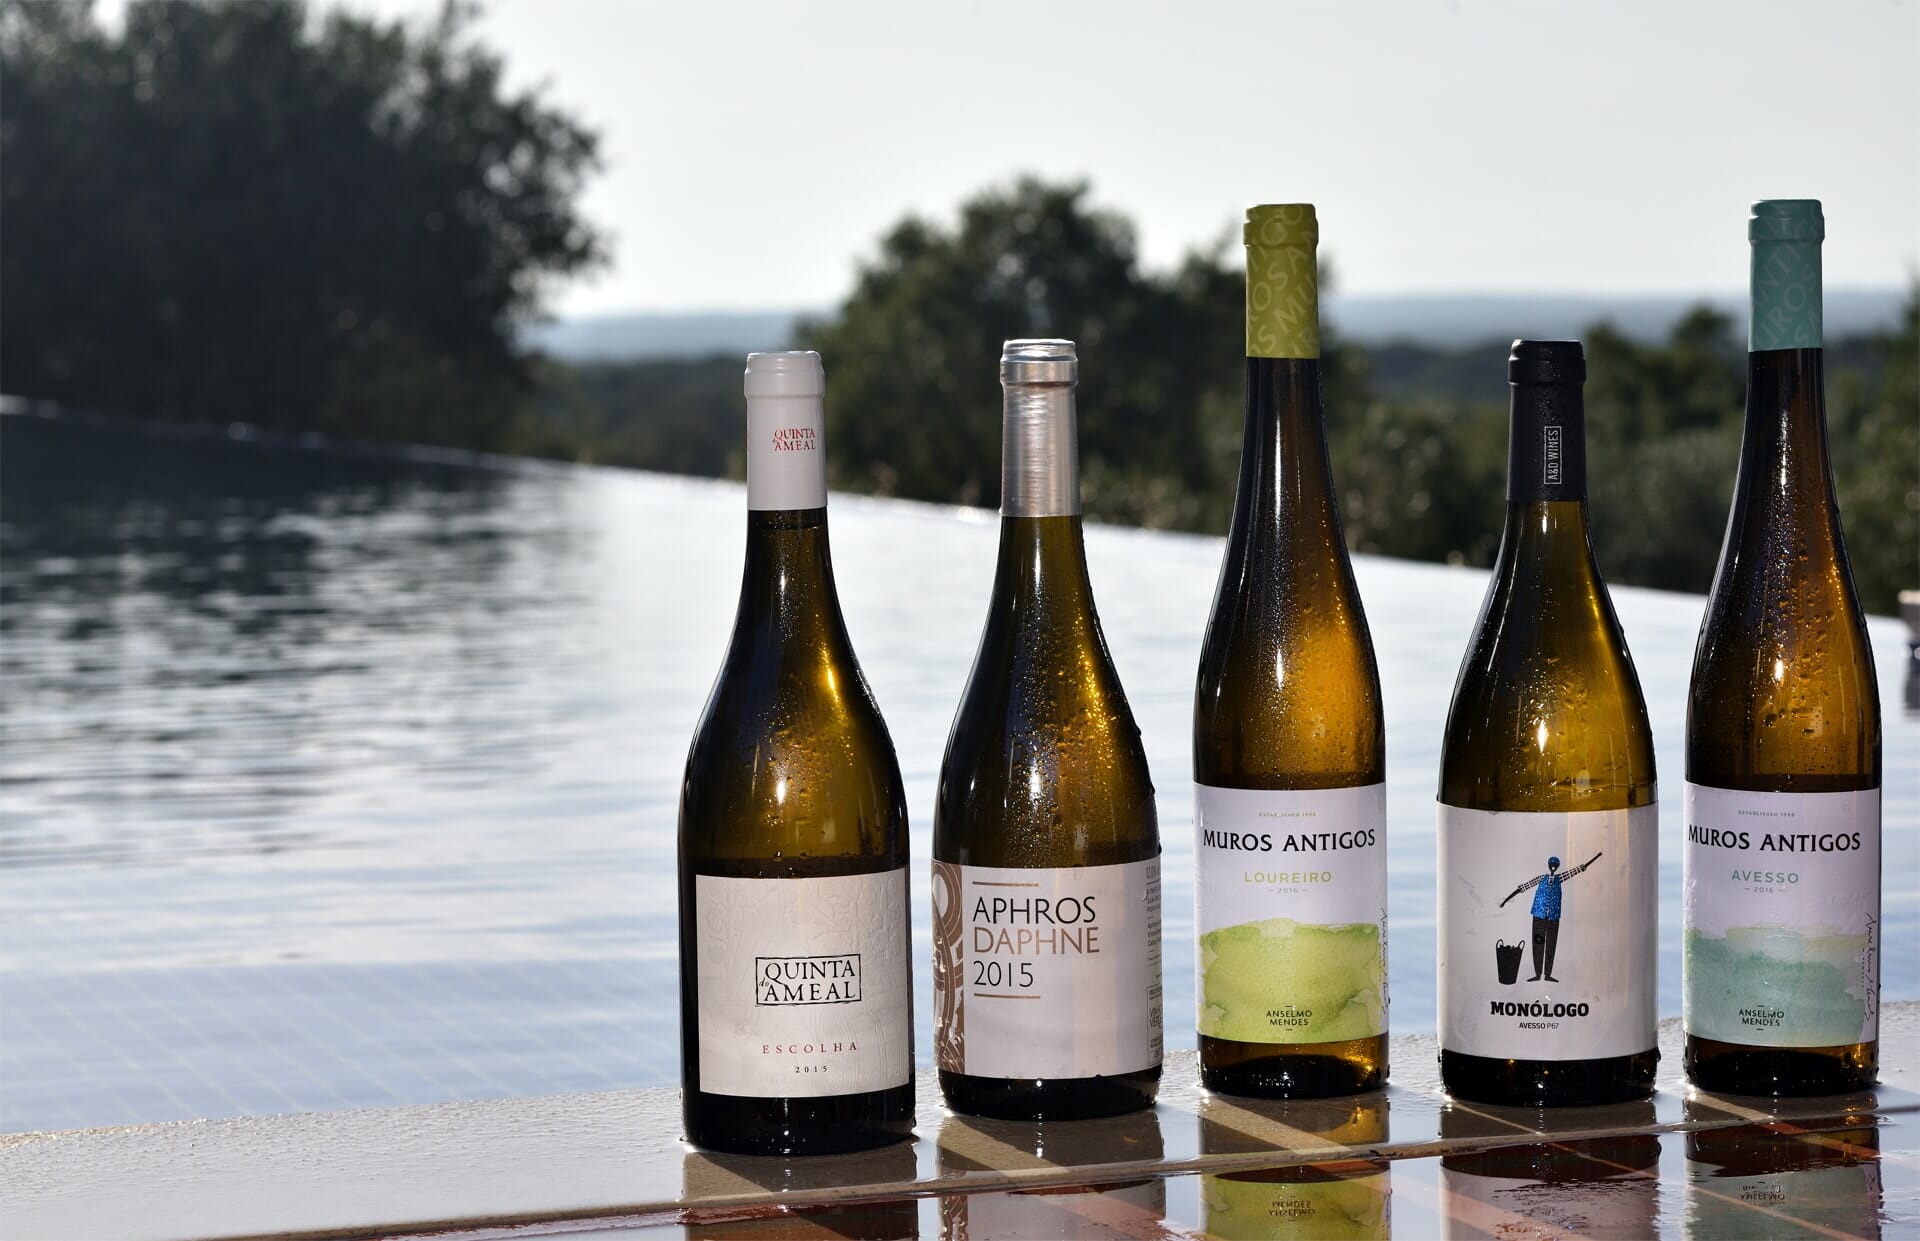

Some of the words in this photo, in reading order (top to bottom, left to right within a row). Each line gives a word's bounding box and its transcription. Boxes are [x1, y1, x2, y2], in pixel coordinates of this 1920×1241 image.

[774, 428, 816, 441] QUINTA
[774, 439, 816, 451] AMEAL
[1547, 430, 1559, 461] WINES
[1547, 462, 1559, 480] A&D
[1203, 828, 1273, 852] MUROS
[1282, 828, 1376, 852] ANTIGOS
[1688, 824, 1750, 850] MUROS
[1759, 832, 1861, 852] ANTIGOS
[1244, 871, 1333, 884] LOUREIRO
[1731, 869, 1799, 884] AVESSO
[1753, 886, 1774, 894] 2016
[972, 896, 1096, 924] APHROS
[973, 926, 1101, 955] DAPHNE
[765, 959, 856, 985] QUINTA
[973, 960, 1034, 988] 2015
[764, 981, 856, 1001] AMEAL
[1266, 1010, 1313, 1018] ANSELMO
[1490, 1000, 1590, 1018] MONÓLOGO
[1738, 1008, 1785, 1018] ANSELMO
[1269, 1018, 1309, 1026] MENDES
[1519, 1021, 1546, 1029] AVESSO
[1547, 1022, 1560, 1030] P67
[1741, 1018, 1780, 1027] MENDES
[762, 1042, 857, 1054] ESCOLHA
[795, 1065, 828, 1073] 2015
